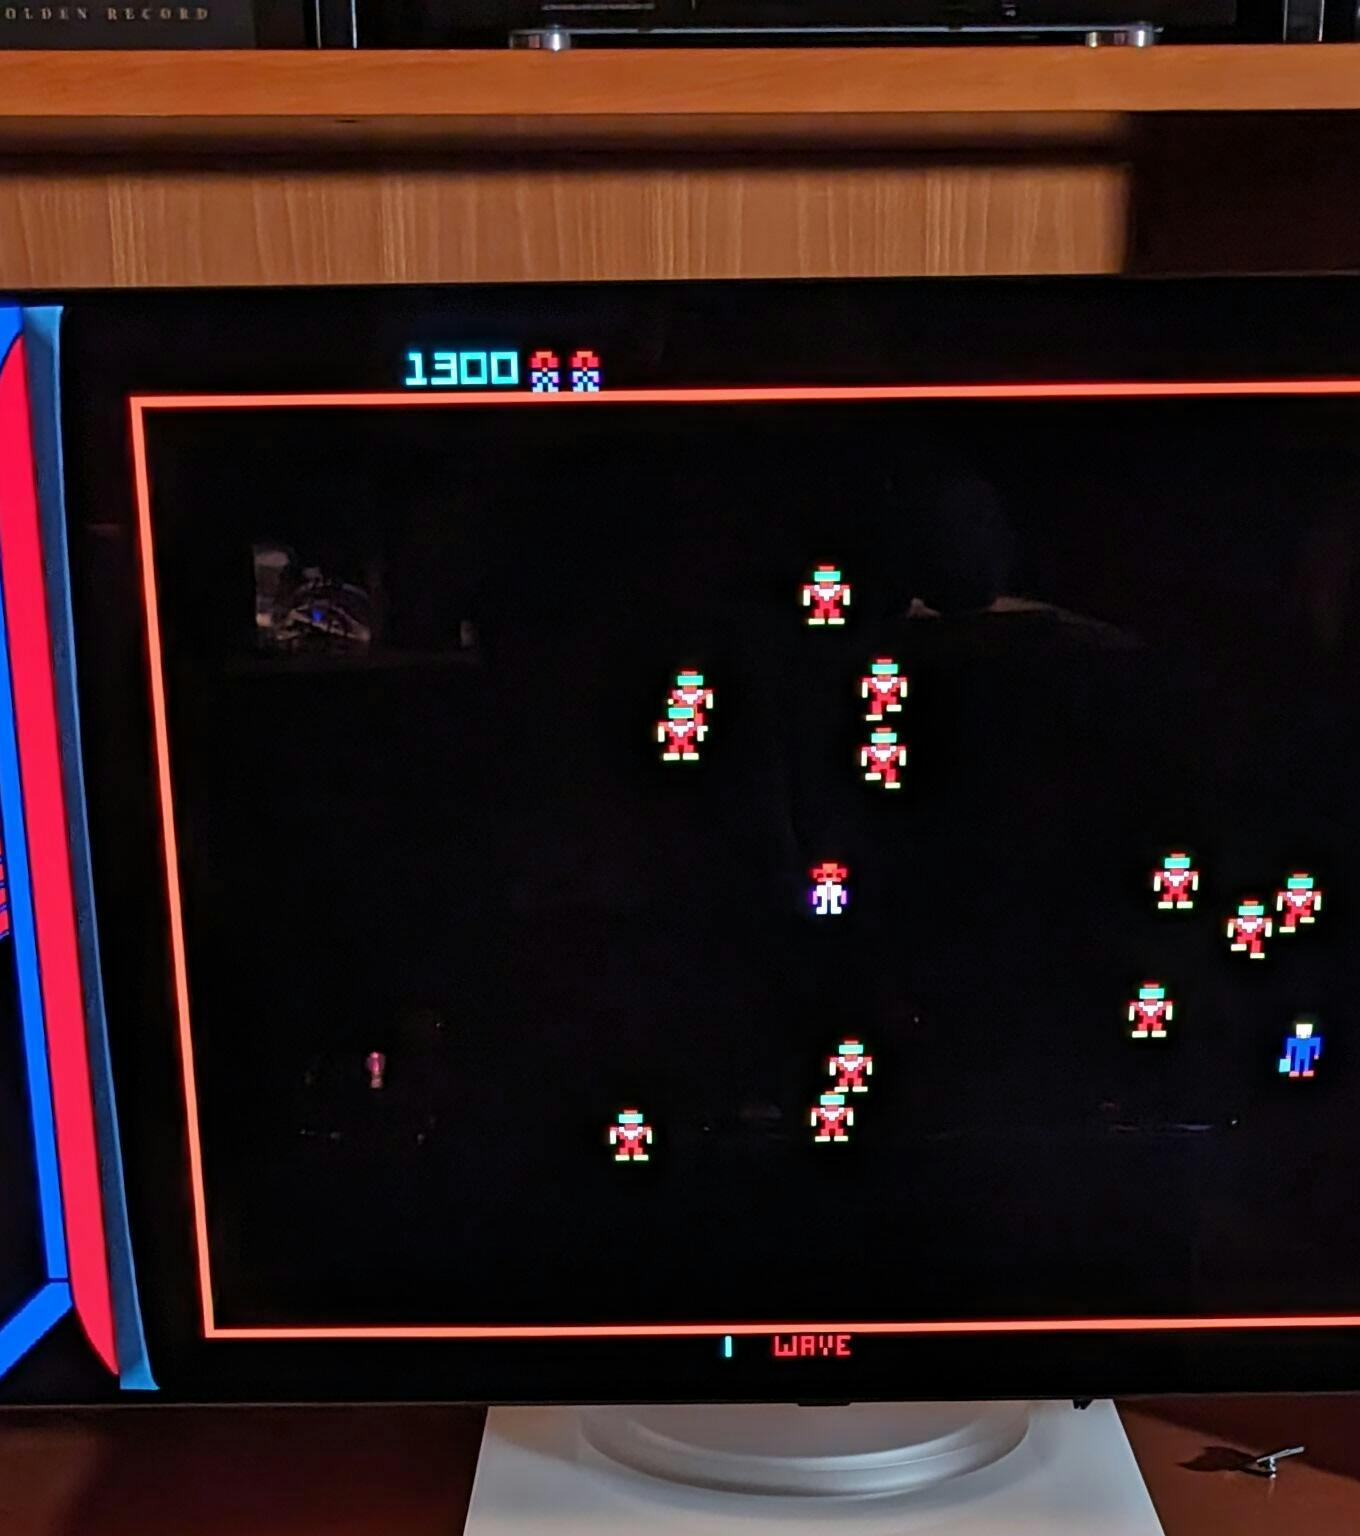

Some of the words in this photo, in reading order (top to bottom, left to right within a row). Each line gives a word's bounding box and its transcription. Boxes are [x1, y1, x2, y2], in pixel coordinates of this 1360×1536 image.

[107, 7, 208, 20] RECORD
[406, 351, 518, 385] 1300
[774, 1335, 851, 1356] WAVE
